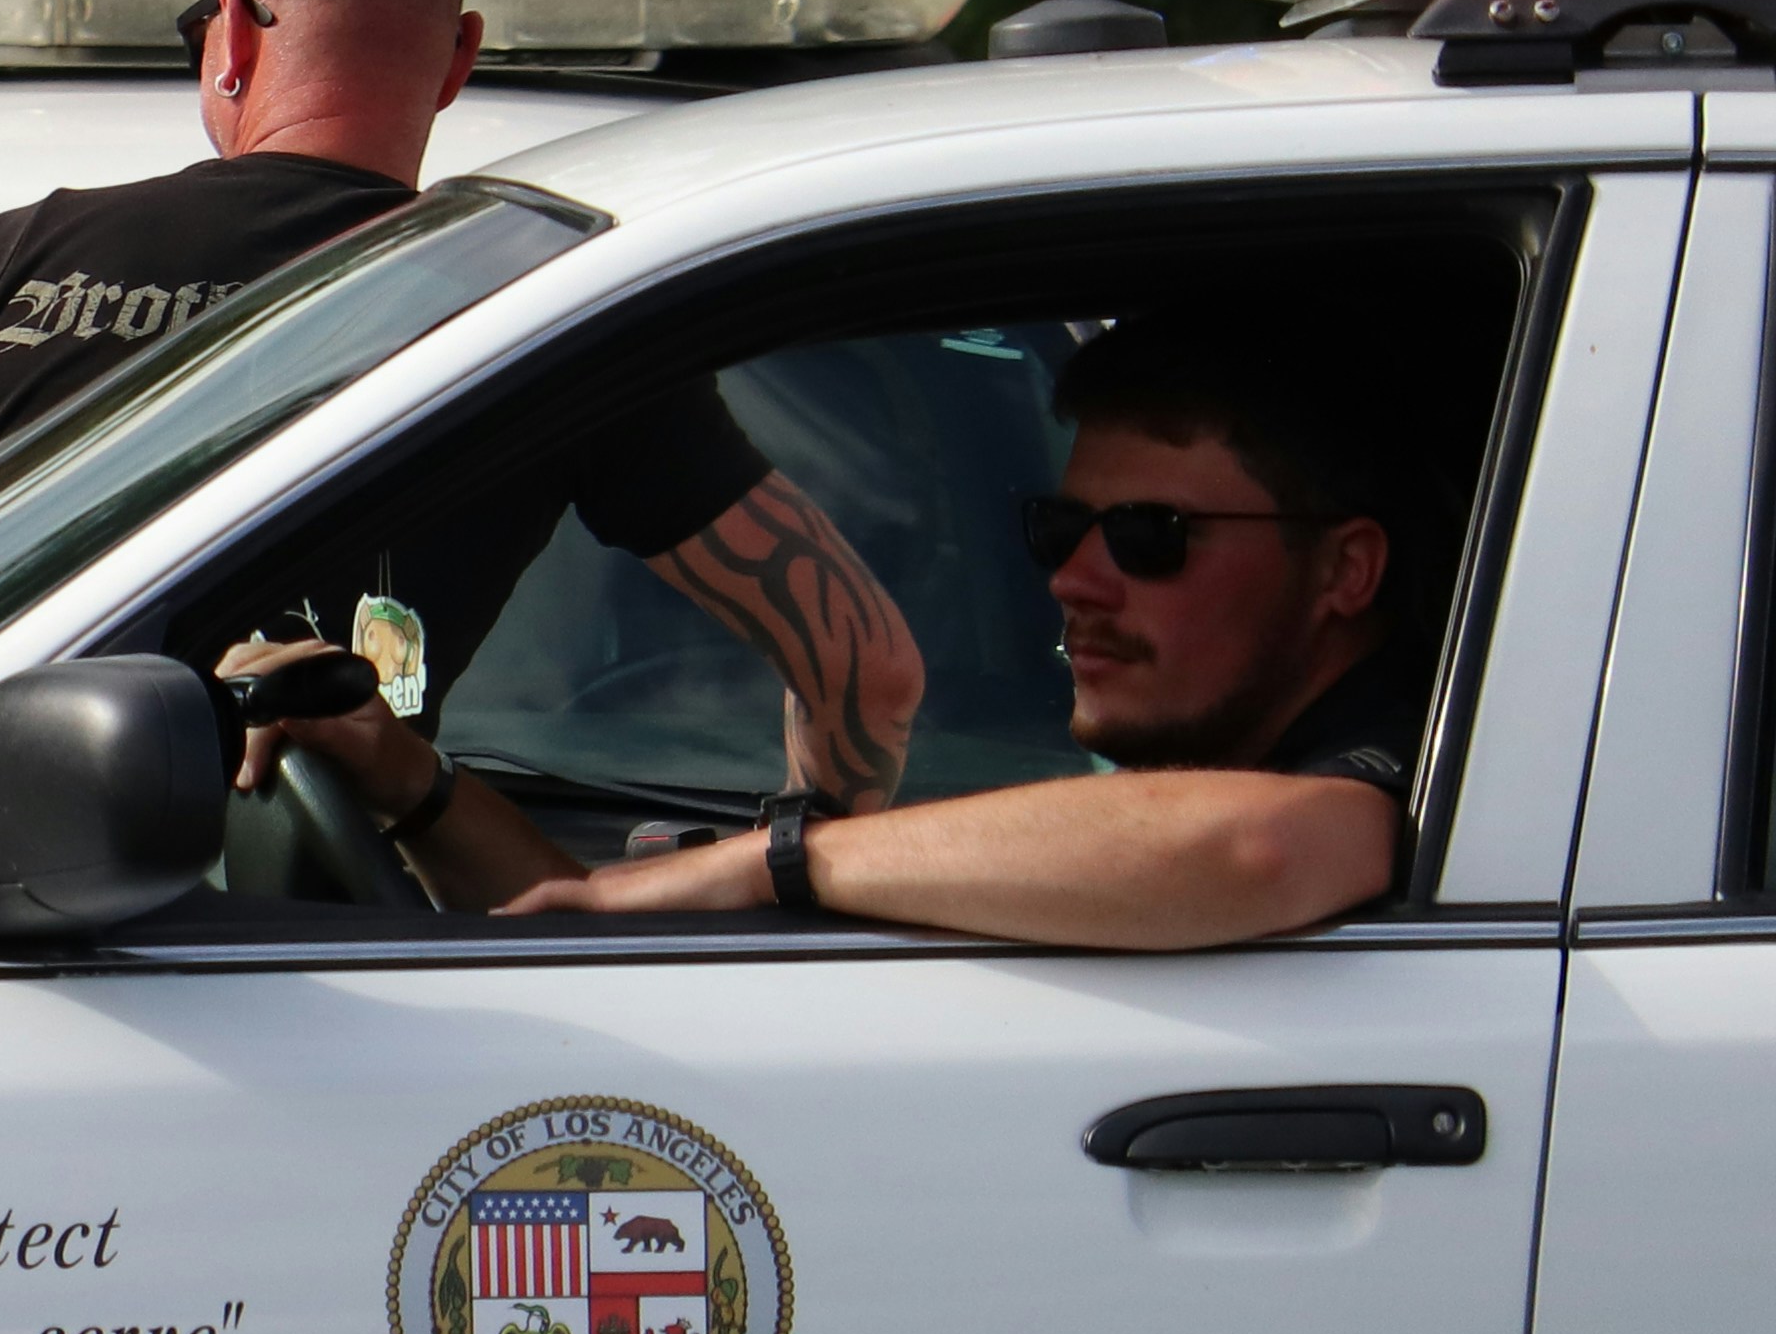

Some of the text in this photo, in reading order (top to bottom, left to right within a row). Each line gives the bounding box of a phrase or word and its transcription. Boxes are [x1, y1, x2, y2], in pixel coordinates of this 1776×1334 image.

[421, 1113, 756, 1228] CITY OF LOS ANGELES
